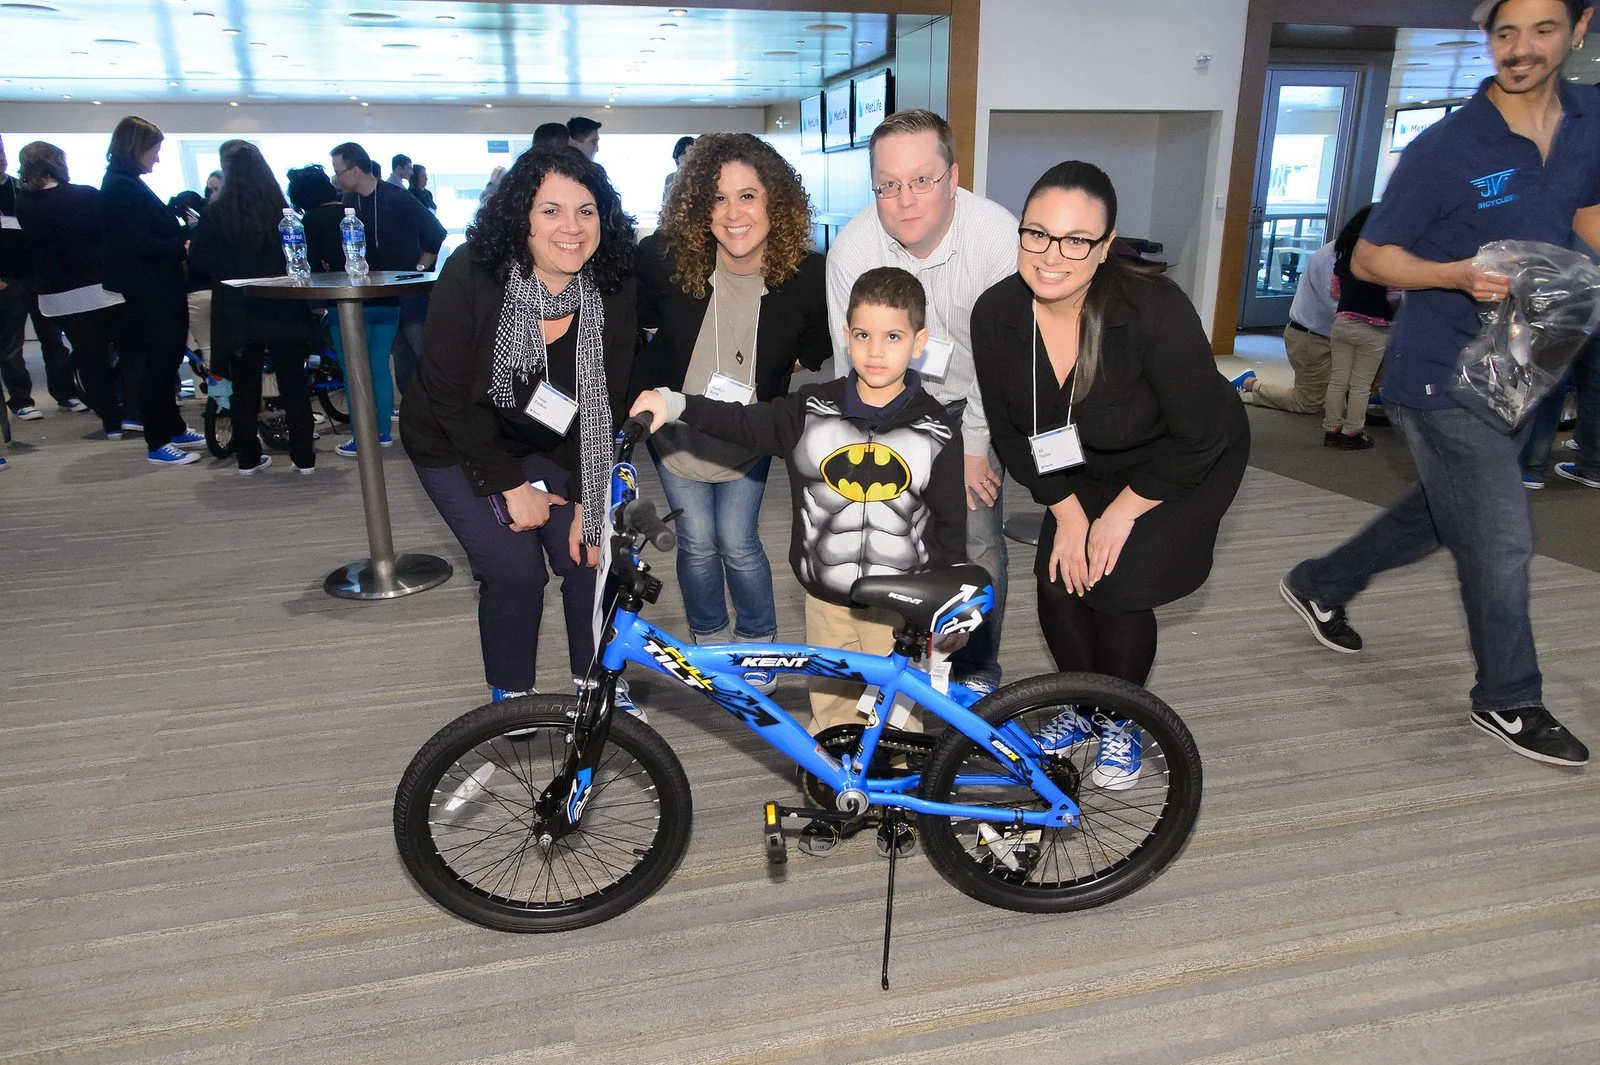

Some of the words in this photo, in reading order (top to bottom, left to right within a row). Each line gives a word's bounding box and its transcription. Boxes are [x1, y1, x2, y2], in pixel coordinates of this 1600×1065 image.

[1477, 194, 1514, 209] BICYCLES
[887, 591, 923, 605] KENT
[643, 640, 705, 689] TILT
[663, 646, 713, 691] FULL
[740, 657, 809, 668] KENT
